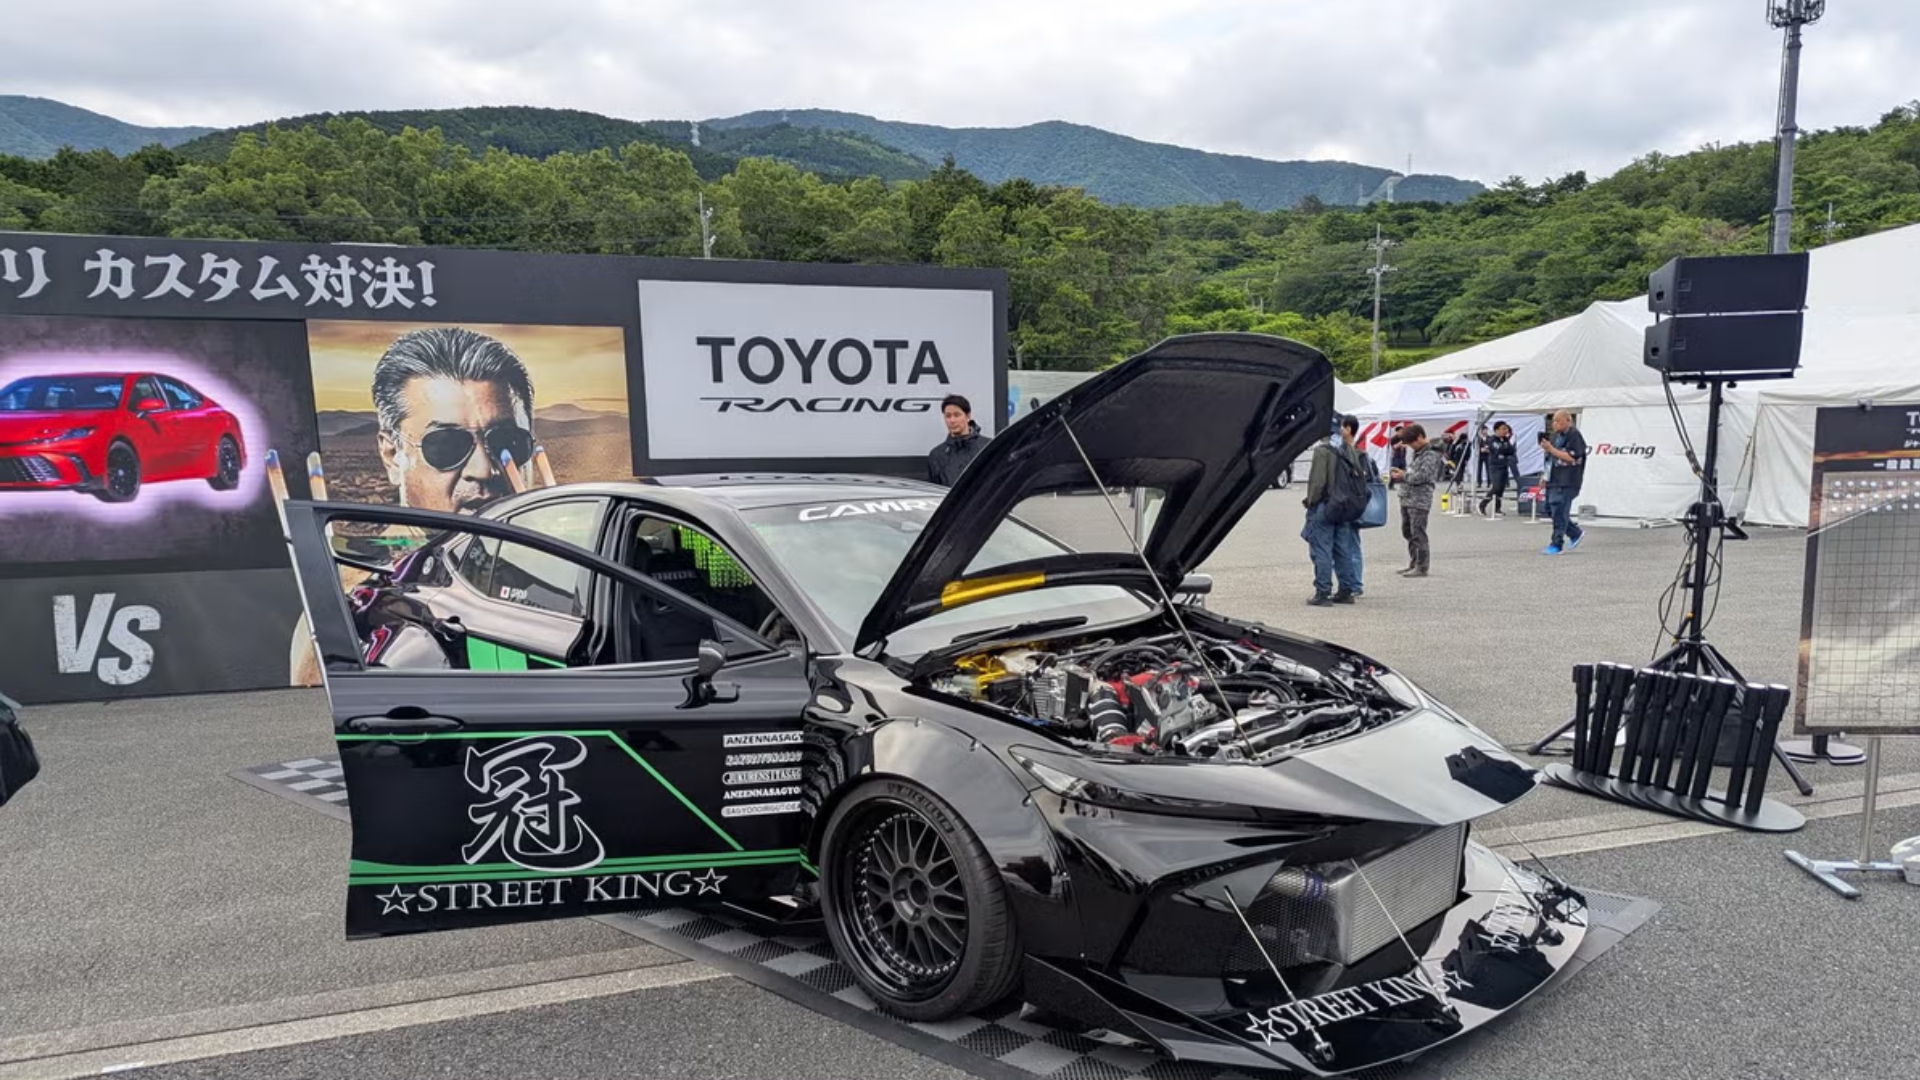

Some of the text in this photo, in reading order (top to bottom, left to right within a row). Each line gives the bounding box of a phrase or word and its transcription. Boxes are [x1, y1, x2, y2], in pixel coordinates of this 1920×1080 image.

[84, 249, 437, 309] カスタム対決!
[696, 336, 950, 386] TOYOTA
[701, 397, 946, 414] RACING
[1596, 442, 1656, 459] Racing
[53, 592, 161, 685] VS
[418, 869, 692, 913] STREET KING
[1267, 986, 1379, 1036] STREET
